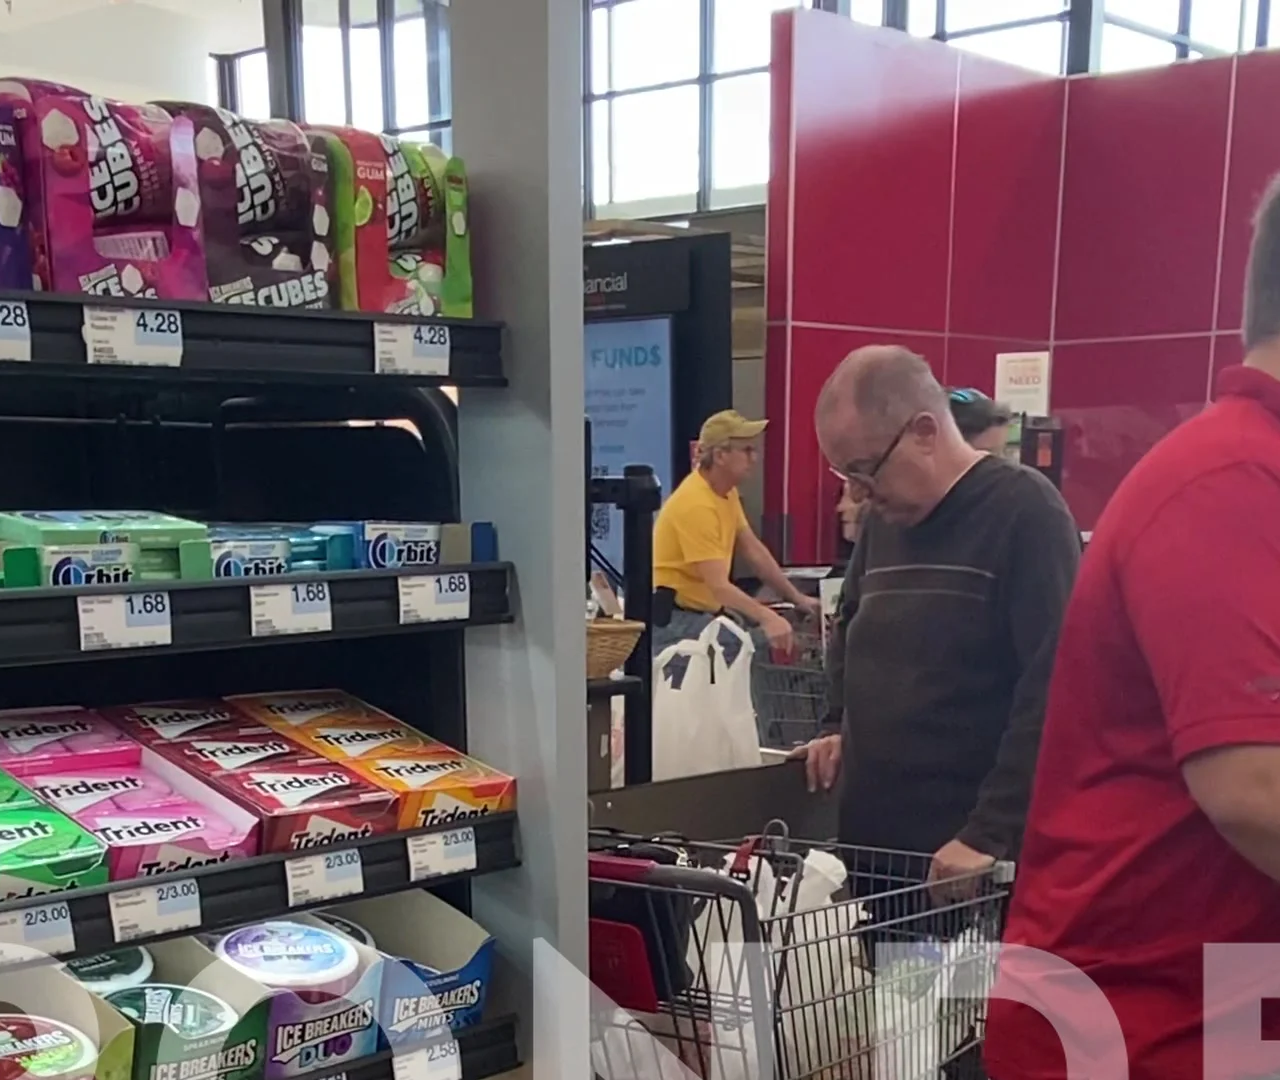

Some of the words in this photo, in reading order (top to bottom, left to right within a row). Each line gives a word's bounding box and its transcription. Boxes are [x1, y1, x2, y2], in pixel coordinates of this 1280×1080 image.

[258, 272, 328, 307] CUBES
[136, 312, 179, 335] 4.28
[414, 326, 447, 345] 4.28
[369, 533, 438, 567] Orbit
[291, 583, 327, 602] 1.68
[435, 574, 468, 592] 1.68
[126, 595, 166, 614] 1.68
[376, 757, 463, 780] Trident
[247, 771, 349, 796] Trident
[95, 815, 202, 843] Trident
[442, 830, 475, 851] 2/3.00
[324, 850, 361, 873] 2/3.00
[157, 881, 197, 902] 2/3.00
[24, 904, 70, 928] 2/3.00
[393, 998, 417, 1019] ICE
[418, 980, 480, 1015] BREAKERS
[276, 1023, 304, 1048] ICE
[305, 1001, 375, 1041] BREAKERS
[299, 1036, 352, 1067] DUO
[427, 1040, 457, 1061] 2.58
